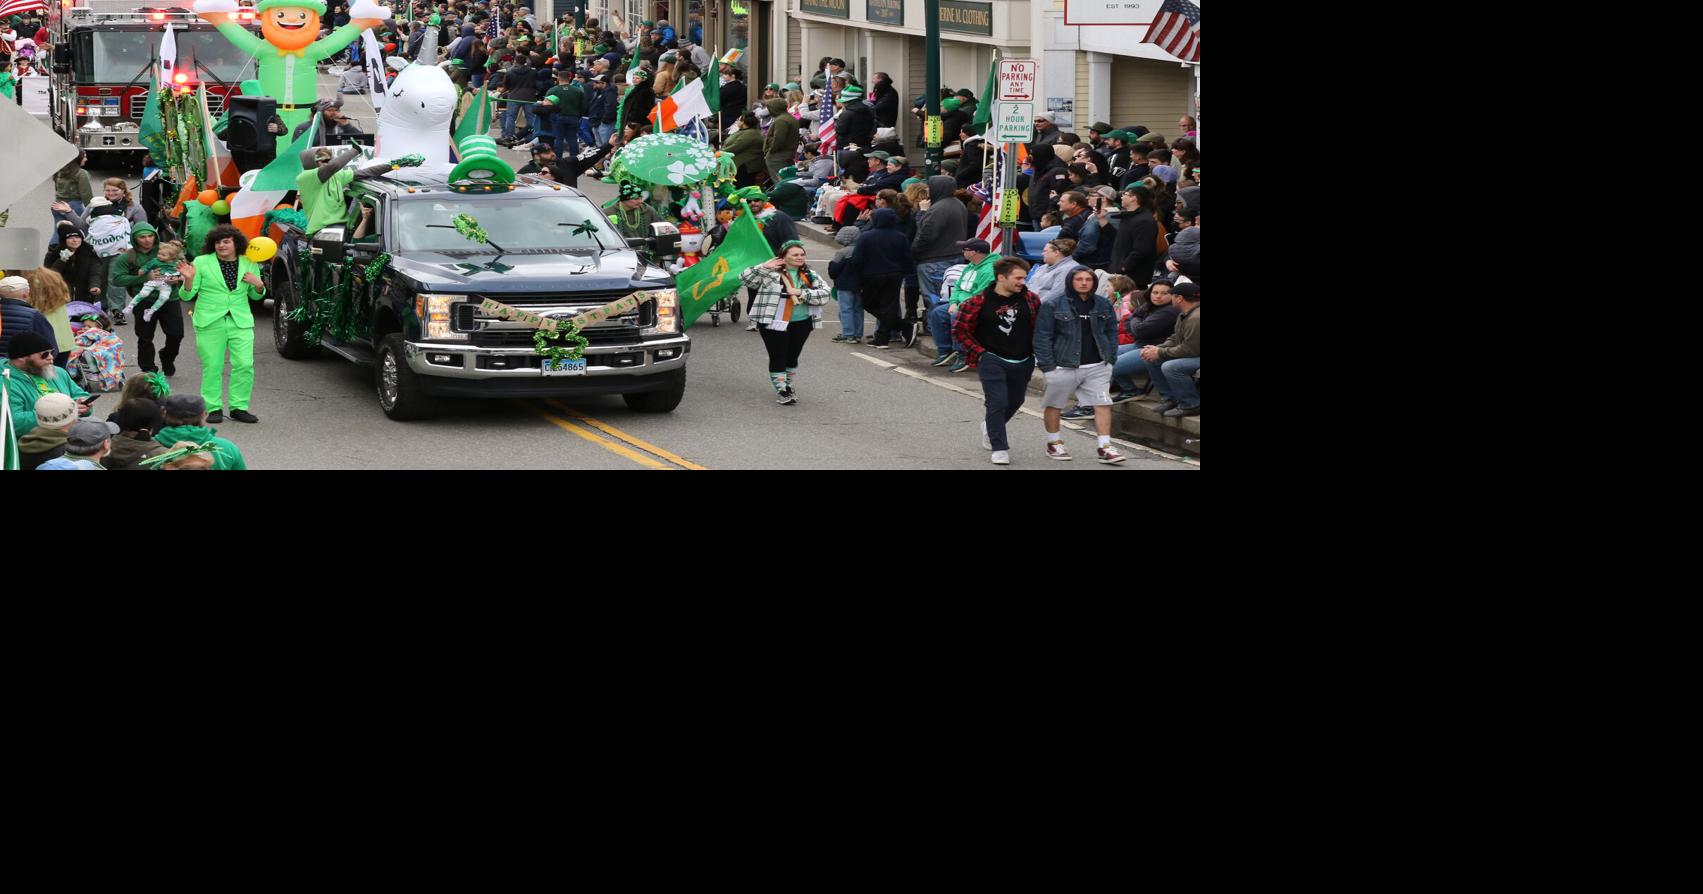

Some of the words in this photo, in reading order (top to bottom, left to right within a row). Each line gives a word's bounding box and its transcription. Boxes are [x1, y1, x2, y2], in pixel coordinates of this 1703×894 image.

[962, 9, 989, 26] CLOTHING
[1011, 64, 1024, 72] NO
[1002, 73, 1033, 81] PARKING
[1012, 105, 1019, 114] 2
